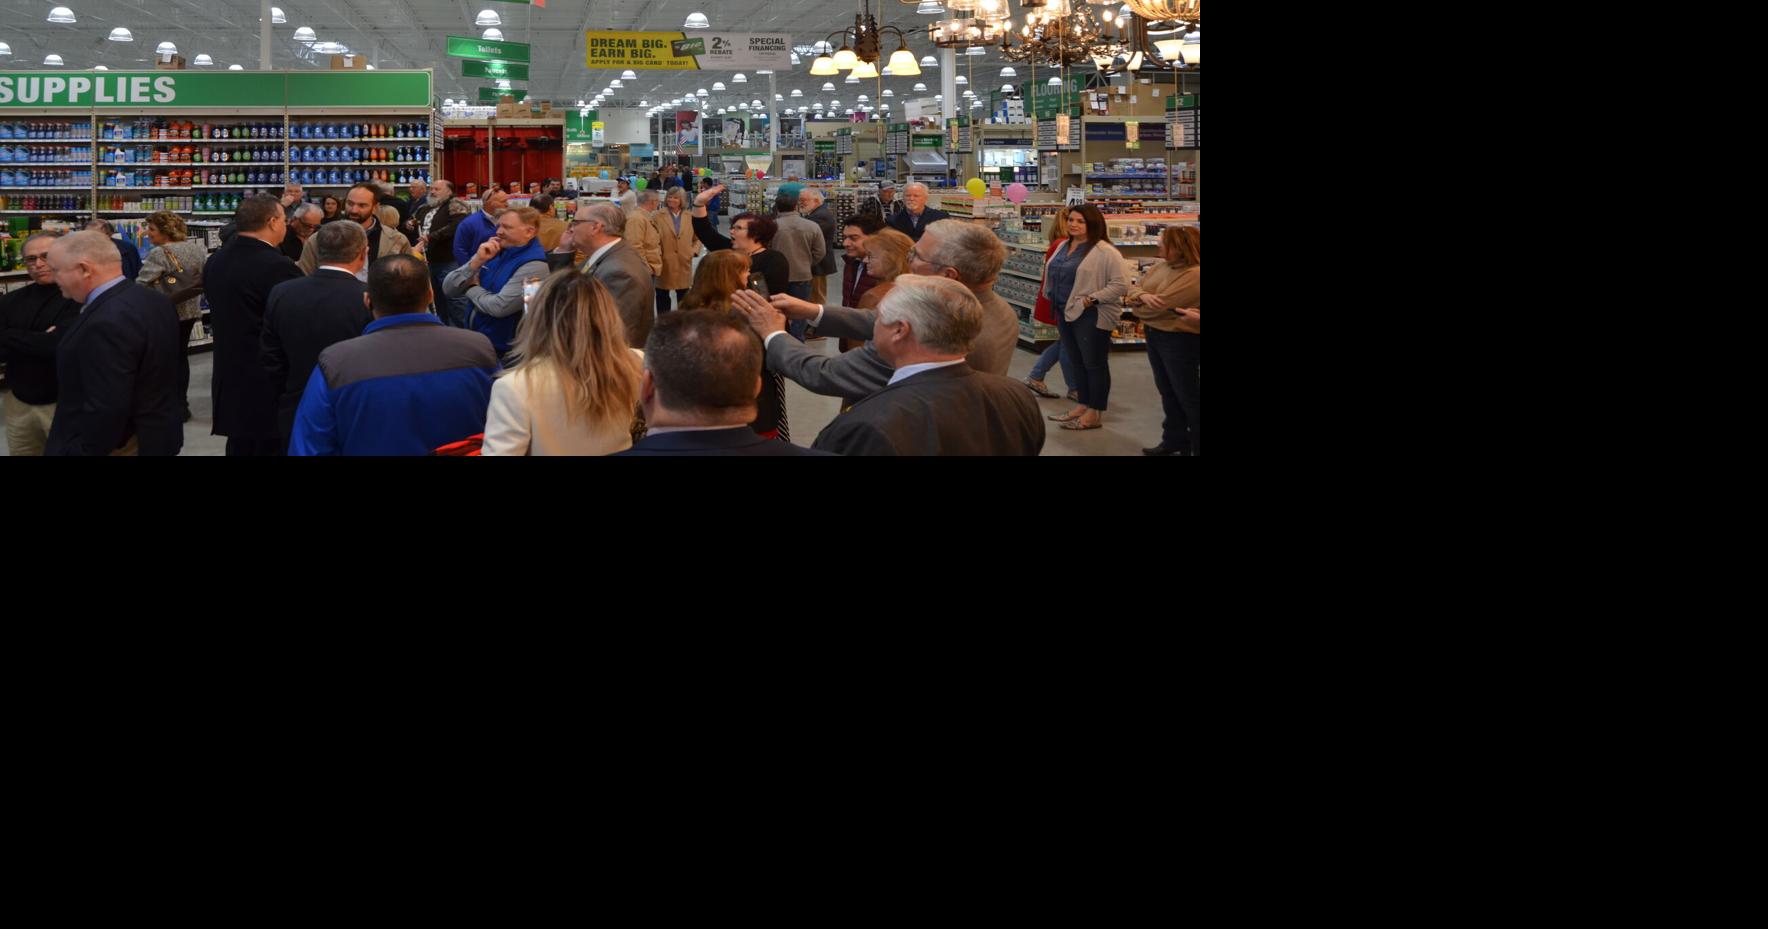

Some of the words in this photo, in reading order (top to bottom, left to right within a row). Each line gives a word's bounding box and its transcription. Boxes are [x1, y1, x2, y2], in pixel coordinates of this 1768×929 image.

[590, 38, 637, 48] DREAM
[642, 39, 667, 49] BIG.
[711, 36, 731, 49] 2%
[749, 37, 785, 45] SPECIAL
[477, 45, 502, 55] Toilets
[590, 48, 625, 58] EARN
[630, 48, 656, 58] BIG.
[0, 76, 176, 103] SUPPLIES
[1031, 79, 1078, 97] FLOORNG
